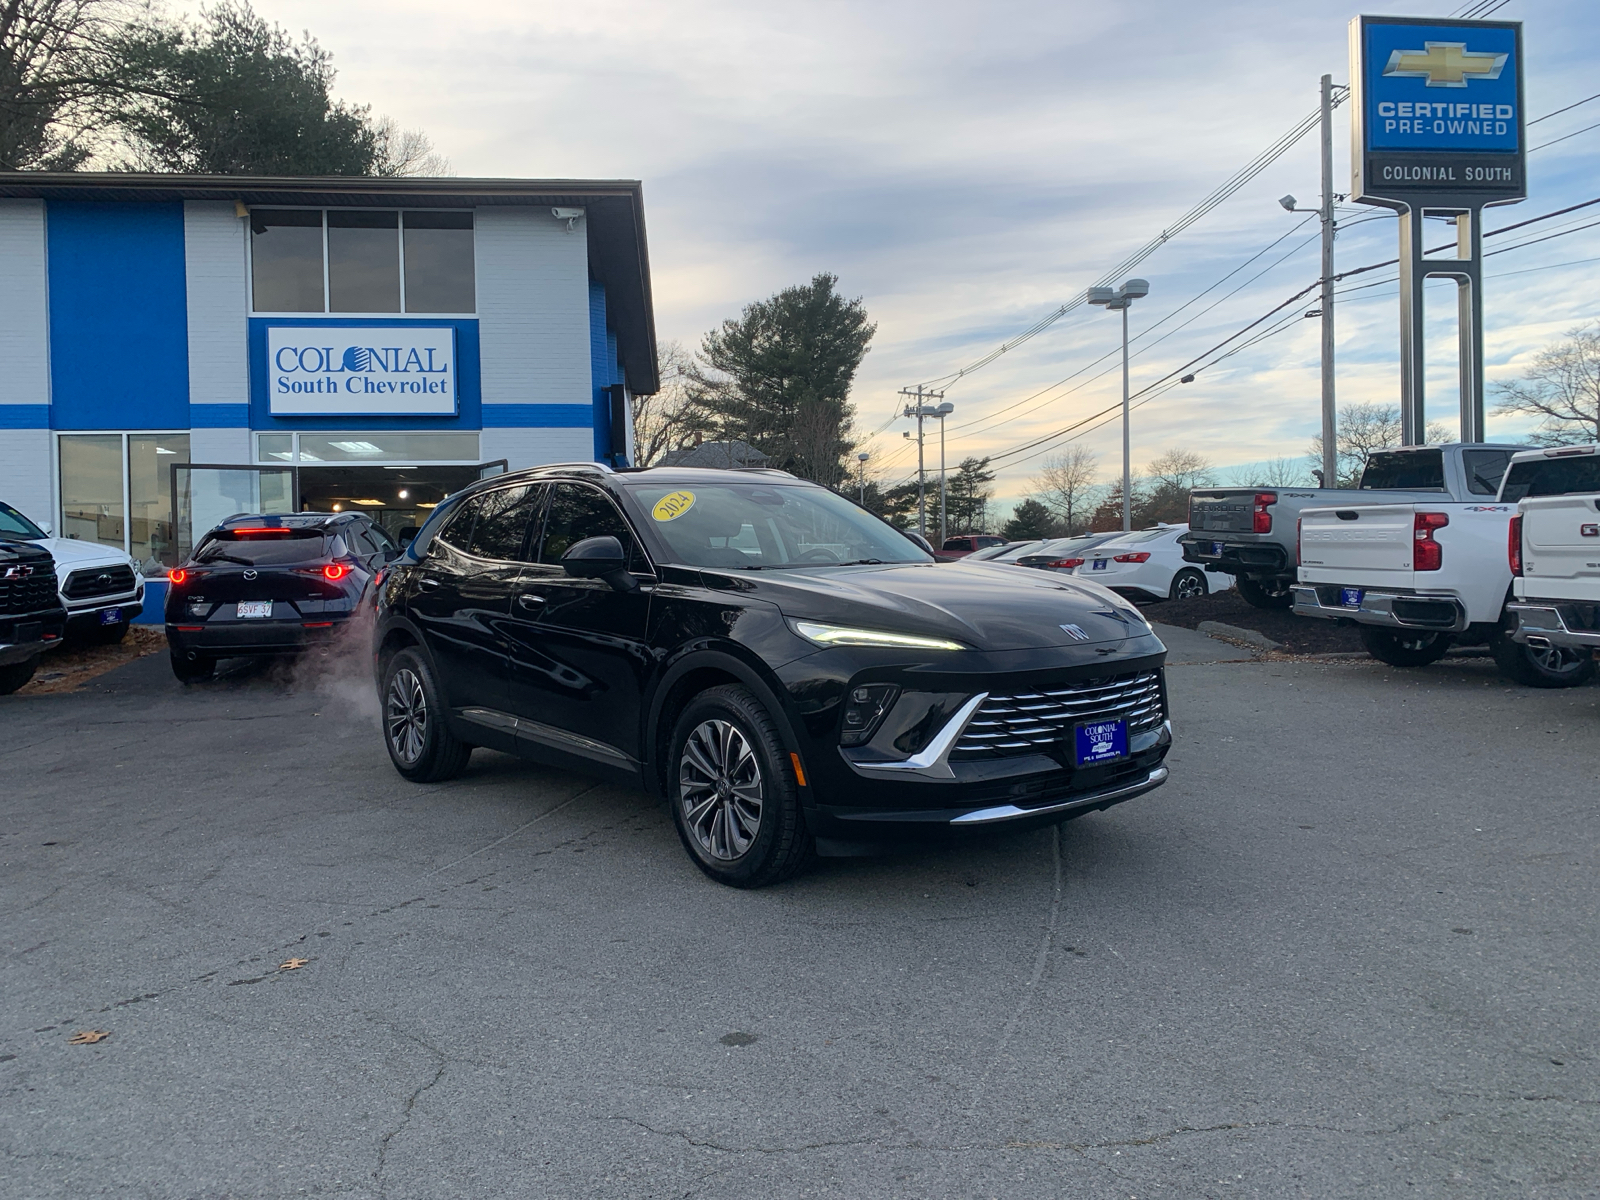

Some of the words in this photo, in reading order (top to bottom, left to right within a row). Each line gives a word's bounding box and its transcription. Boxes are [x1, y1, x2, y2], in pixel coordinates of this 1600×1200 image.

[1378, 102, 1513, 119] CERTIFIED
[1385, 119, 1507, 135] PRE-OWNED
[1383, 166, 1456, 180] COLONIAL
[1465, 167, 1512, 181] SOUTH
[275, 345, 448, 373] COLONIAL
[277, 376, 338, 394] South
[345, 376, 448, 394] Chevrolet
[659, 492, 690, 517] 2024
[1193, 505, 1249, 513] CHEVROLET
[1304, 530, 1401, 541] CHEVROLET
[238, 605, 259, 614] 6SVF
[261, 605, 271, 613] 37
[1085, 723, 1117, 736] COLONIAL
[1090, 732, 1113, 743] SOUTH
